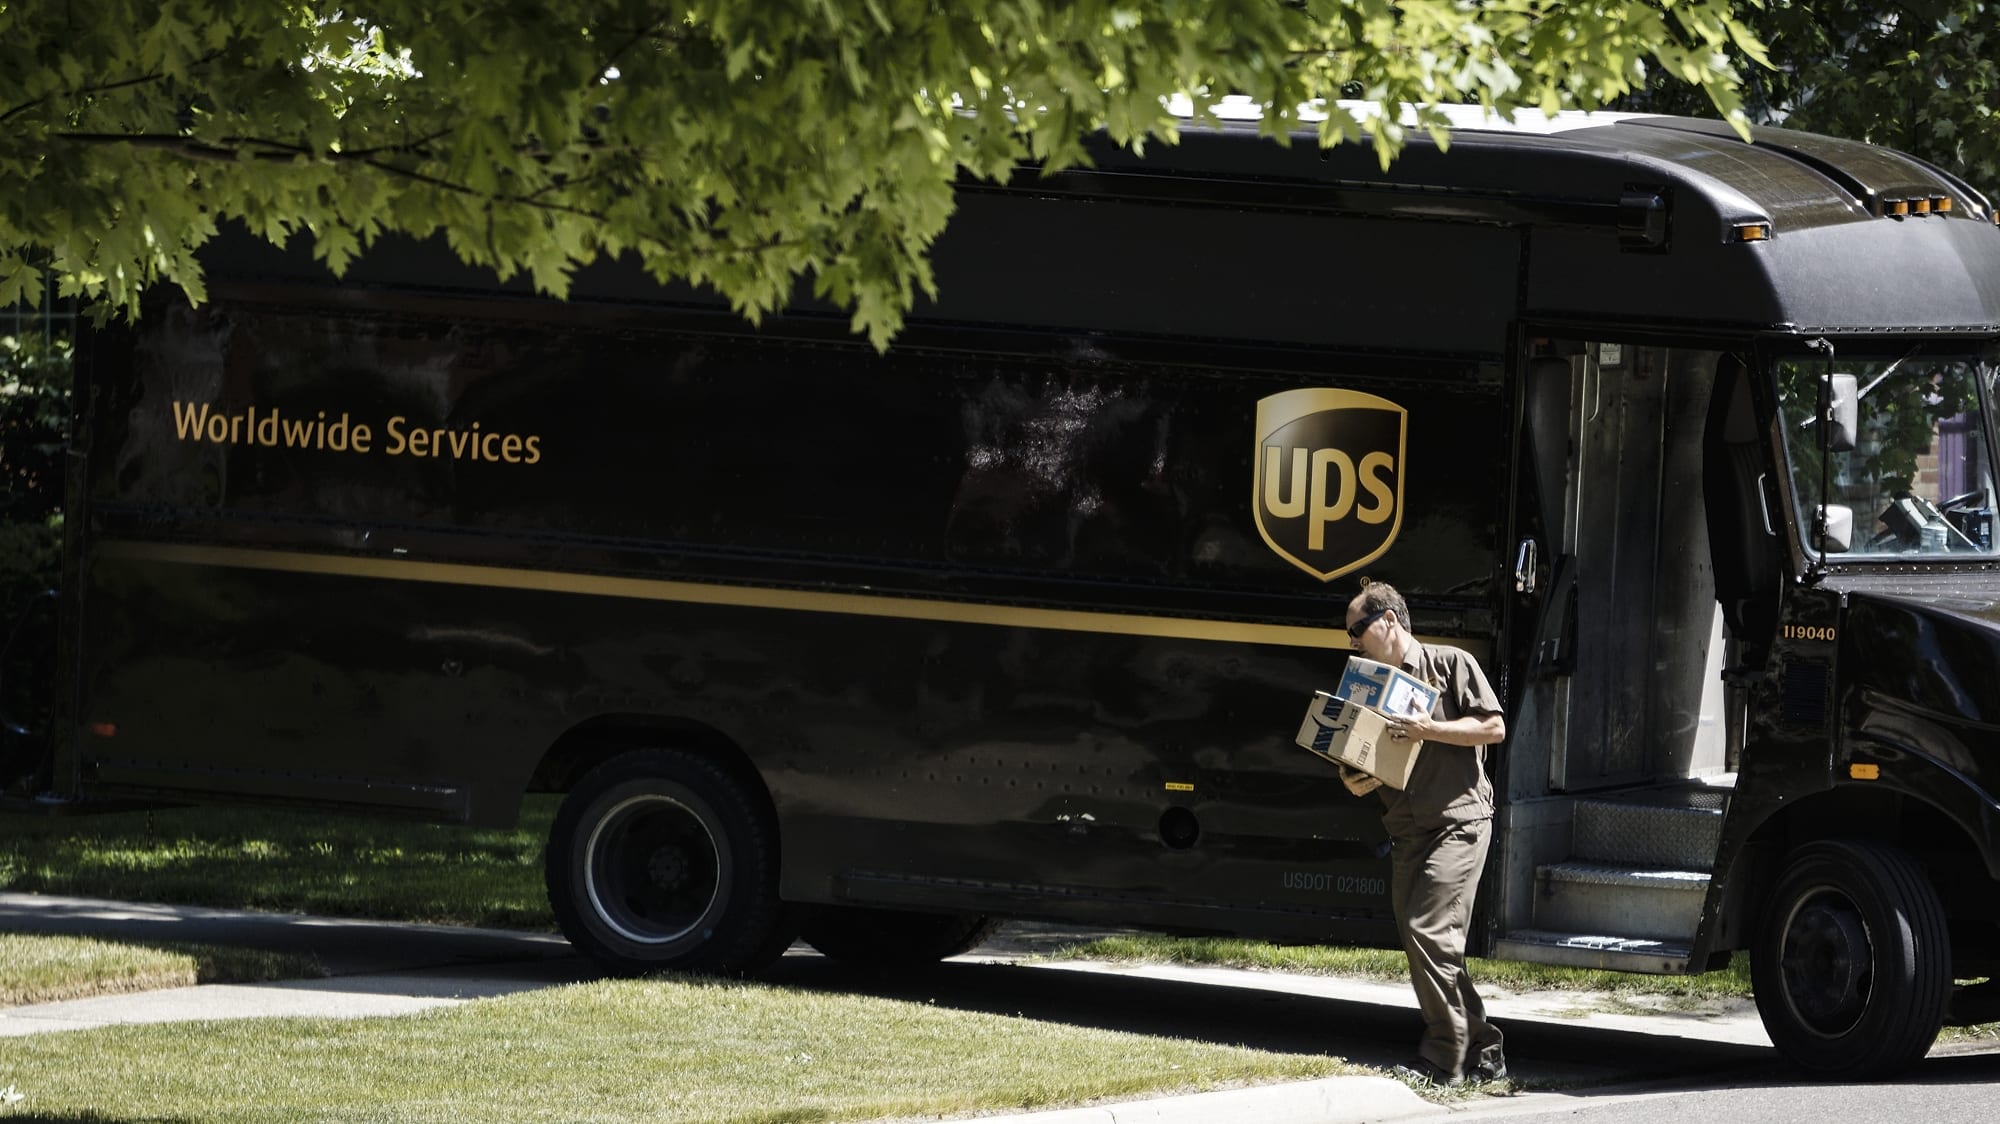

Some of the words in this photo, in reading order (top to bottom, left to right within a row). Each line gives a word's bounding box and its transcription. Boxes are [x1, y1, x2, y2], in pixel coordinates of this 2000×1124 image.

[172, 401, 372, 453] Worldwide
[385, 415, 541, 464] Services
[1264, 446, 1394, 551] ups
[1784, 625, 1836, 641] 119040
[1283, 871, 1333, 892] USDOT
[1337, 875, 1386, 896] 021800
